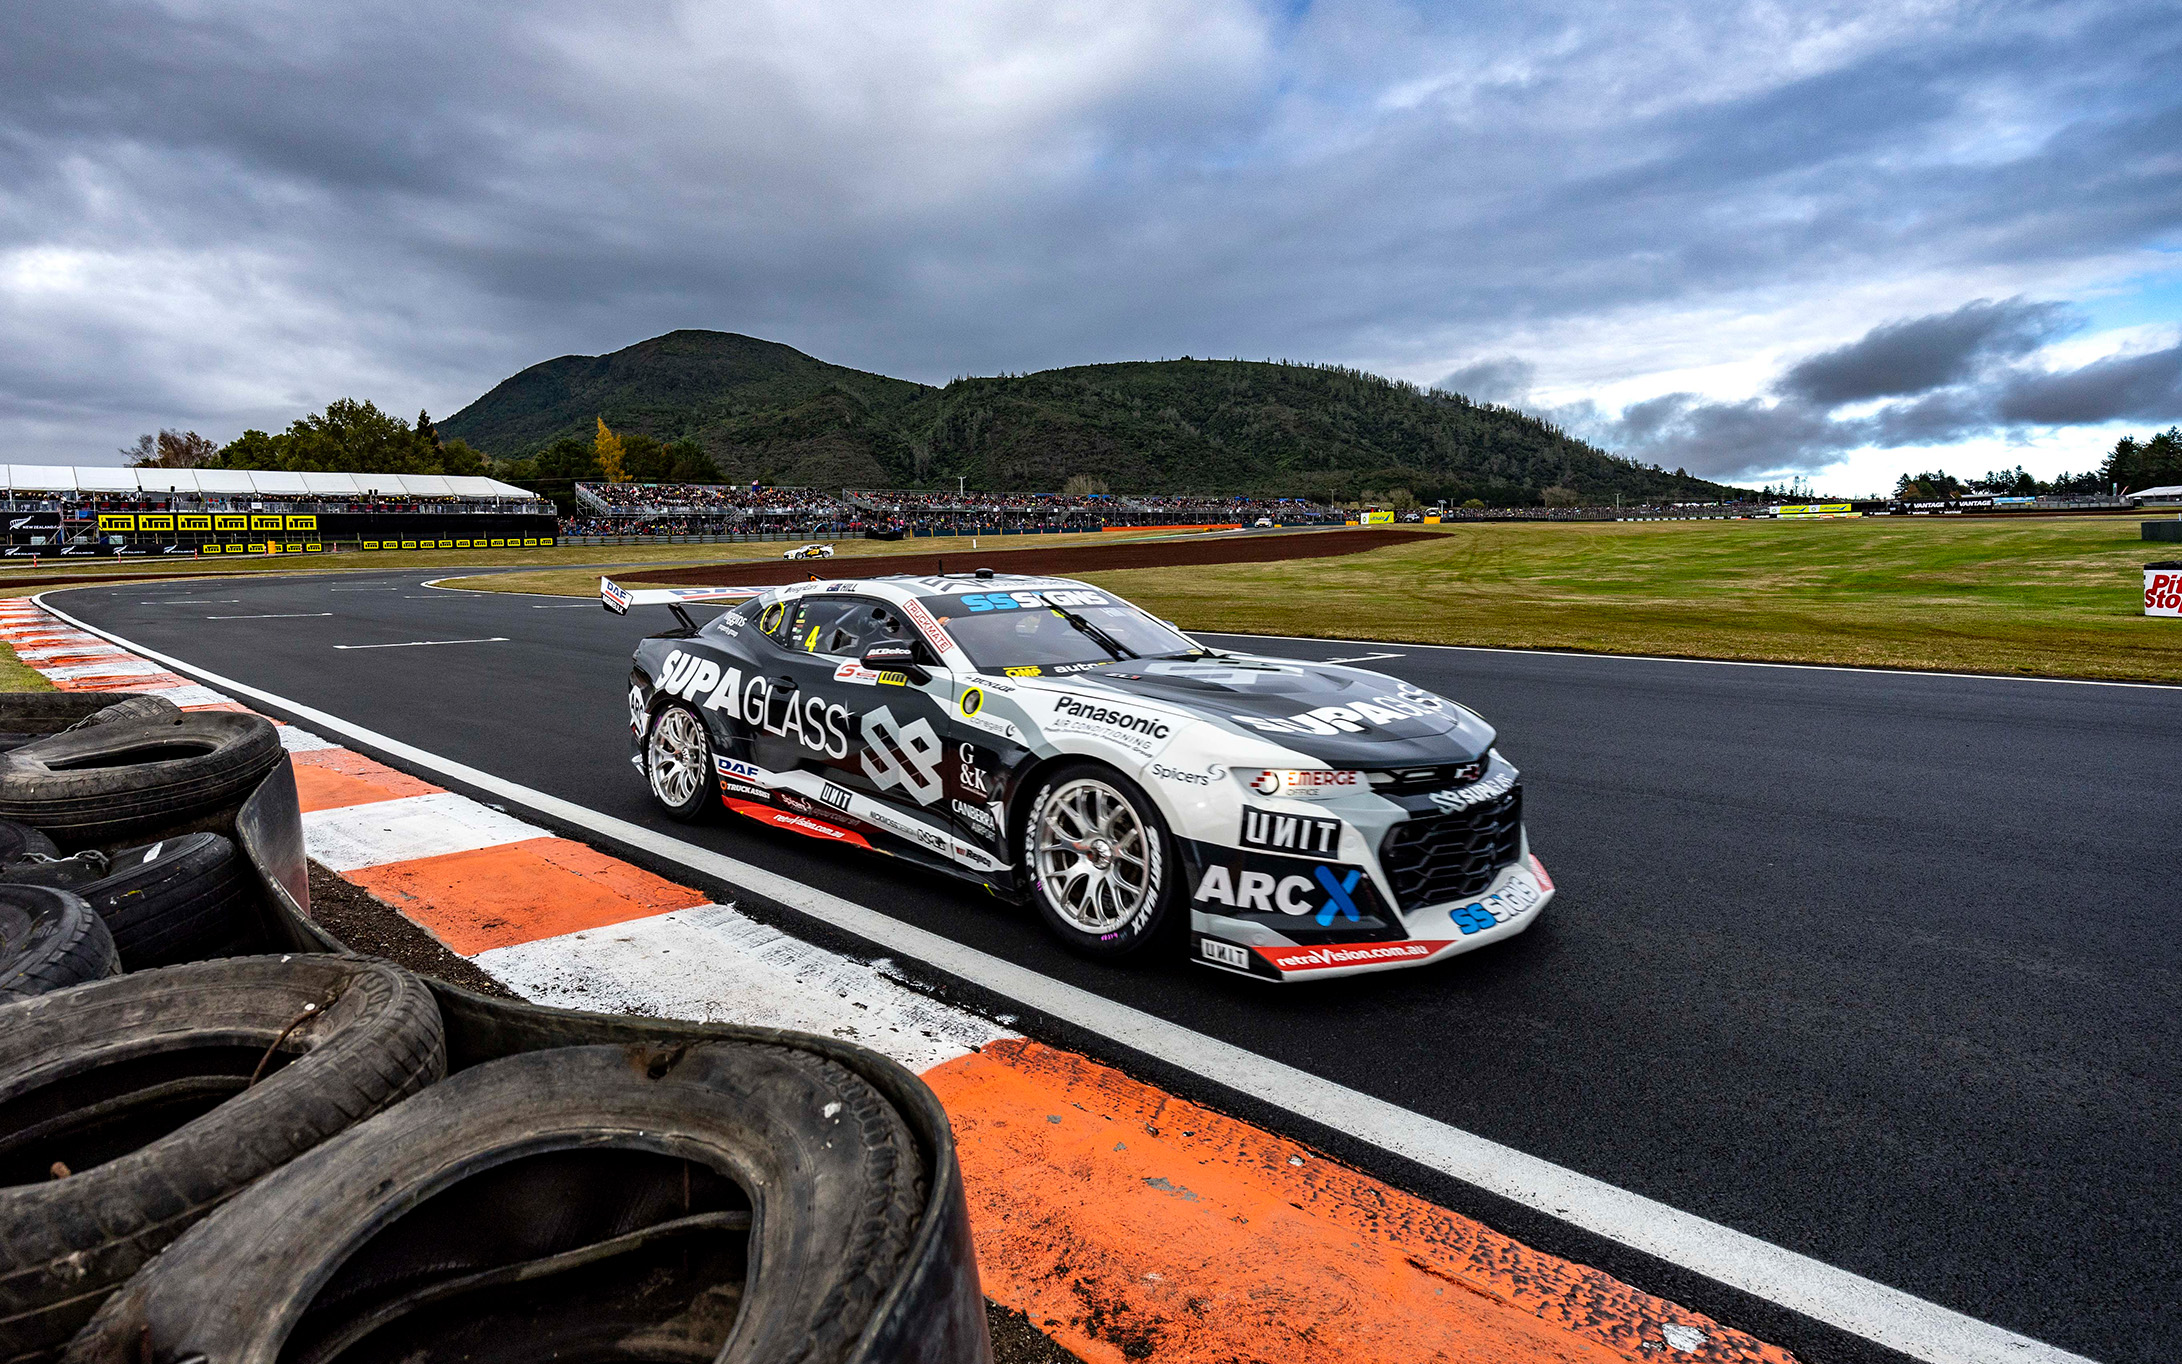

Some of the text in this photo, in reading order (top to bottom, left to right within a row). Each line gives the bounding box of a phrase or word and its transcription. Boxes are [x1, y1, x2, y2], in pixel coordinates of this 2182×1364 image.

[606, 581, 627, 599] DAF
[2152, 574, 2182, 596] Pit
[907, 602, 949, 650] TRUCKMATE
[804, 625, 821, 652] 4
[868, 647, 911, 656] ACDelco
[1005, 668, 1042, 678] OMP
[972, 677, 1015, 693] DUNLOP
[970, 716, 1003, 732] coregas
[1053, 696, 1170, 739] Panasonic
[1052, 719, 1070, 728] AIR
[1071, 721, 1152, 749] CONDITIONING
[959, 742, 974, 764] G
[718, 758, 759, 776] DAF
[1151, 763, 1209, 786] Spicers
[1288, 770, 1357, 786] EMERGE
[822, 784, 851, 809] UNIT
[1286, 788, 1320, 796] OFFICE
[952, 799, 995, 831] CANBERRA
[1025, 784, 1051, 868] DUNLOP
[1246, 811, 1336, 852] UNIT
[966, 848, 992, 868] Repco
[1130, 884, 1160, 936] MAXX
[1203, 940, 1245, 965] UNIT
[1277, 945, 1429, 967] retraVision.com.au
